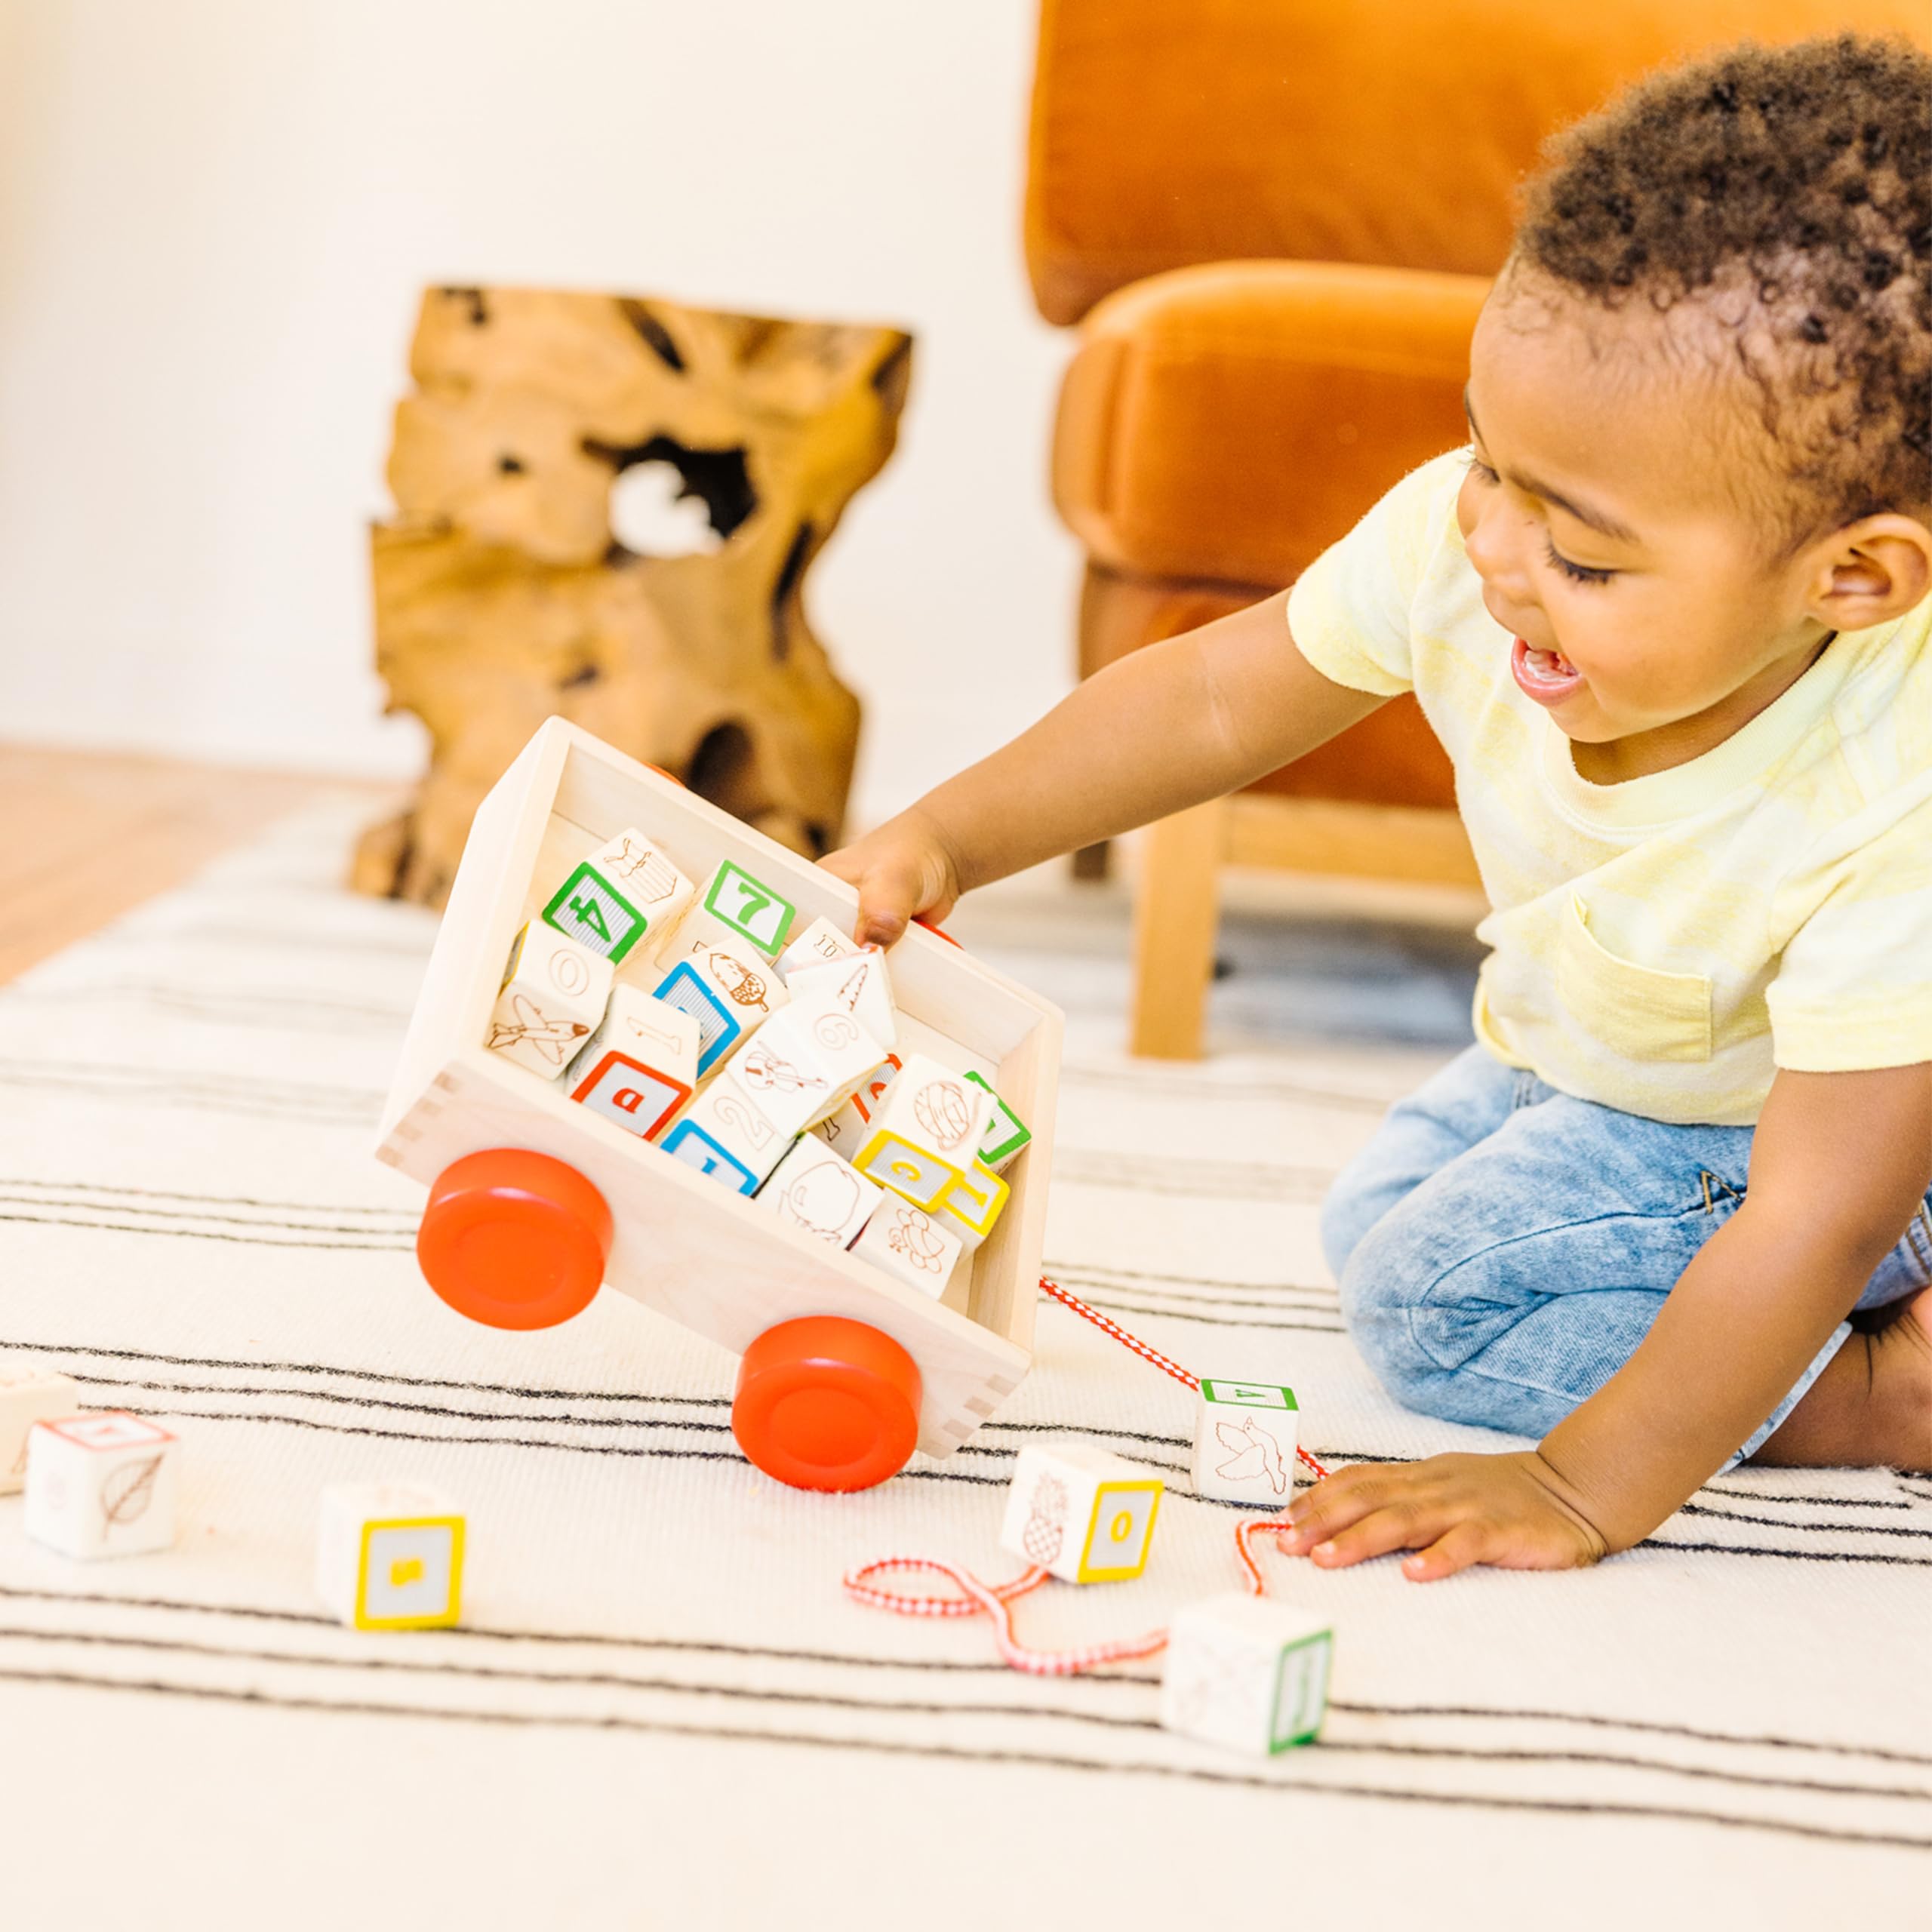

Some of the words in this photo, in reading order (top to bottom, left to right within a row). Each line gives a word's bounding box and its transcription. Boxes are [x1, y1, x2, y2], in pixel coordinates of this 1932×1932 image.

[569, 896, 611, 943] 4
[737, 881, 771, 925] 7
[611, 1088, 645, 1114] a
[713, 1096, 775, 1152] 2
[891, 1161, 921, 1182] c
